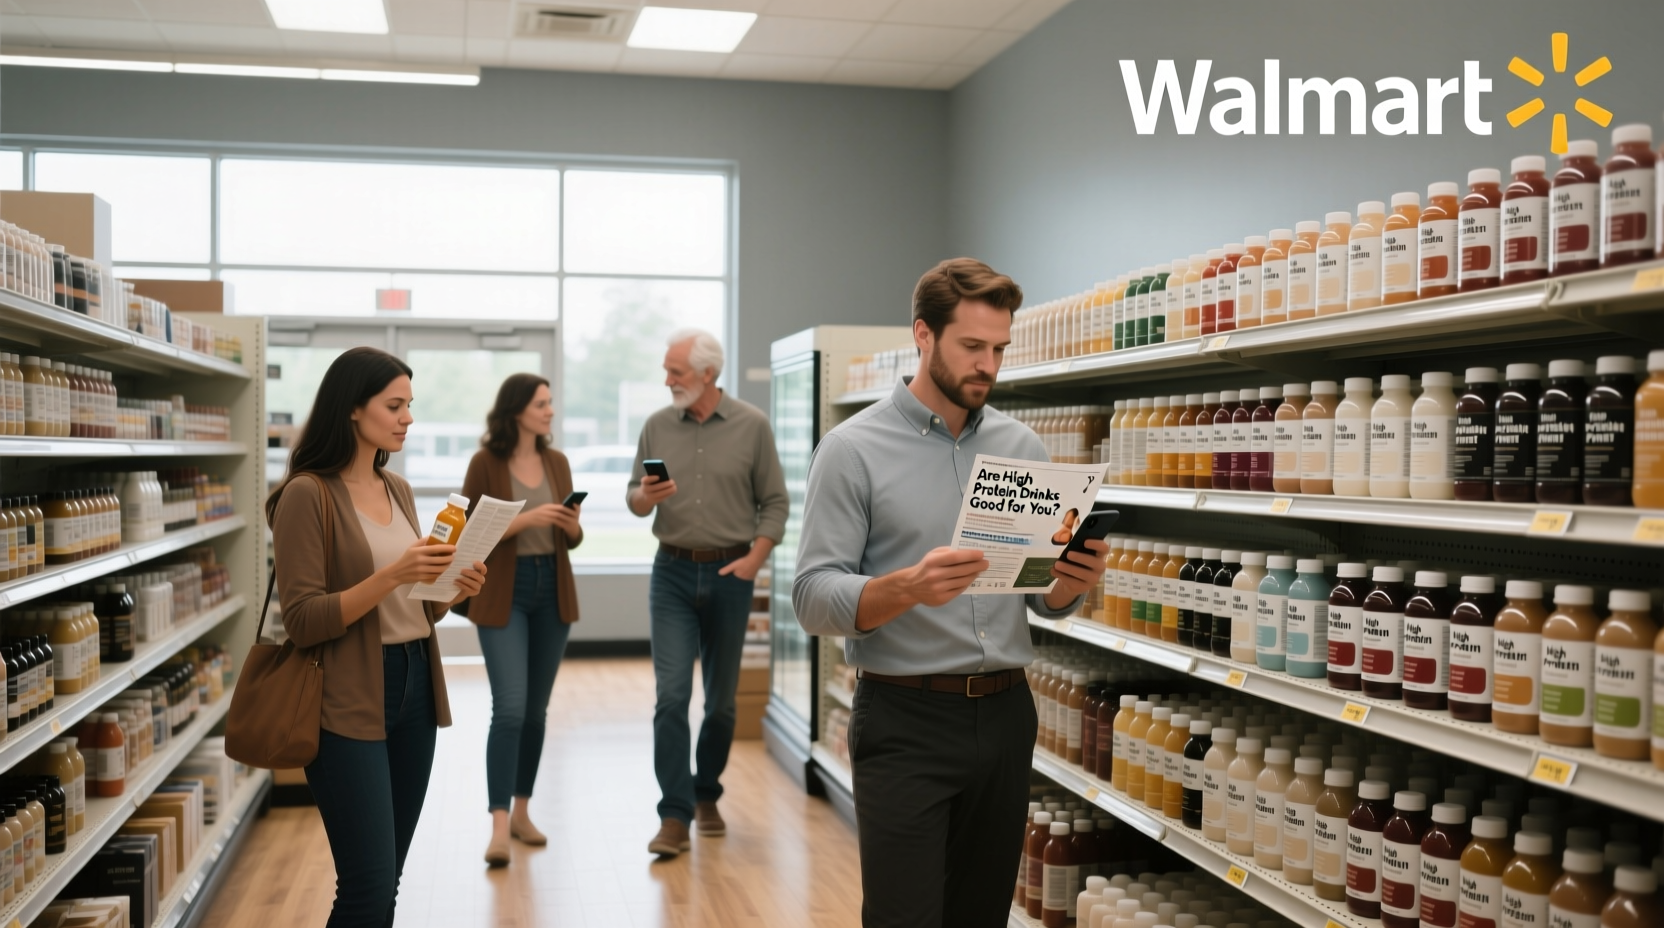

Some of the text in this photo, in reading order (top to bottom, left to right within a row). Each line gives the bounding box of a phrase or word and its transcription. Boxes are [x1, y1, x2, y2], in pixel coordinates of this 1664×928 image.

[977, 468, 1033, 487] Are High
[973, 482, 1060, 500] Protein Drinks
[970, 497, 1060, 516] Good for You?
